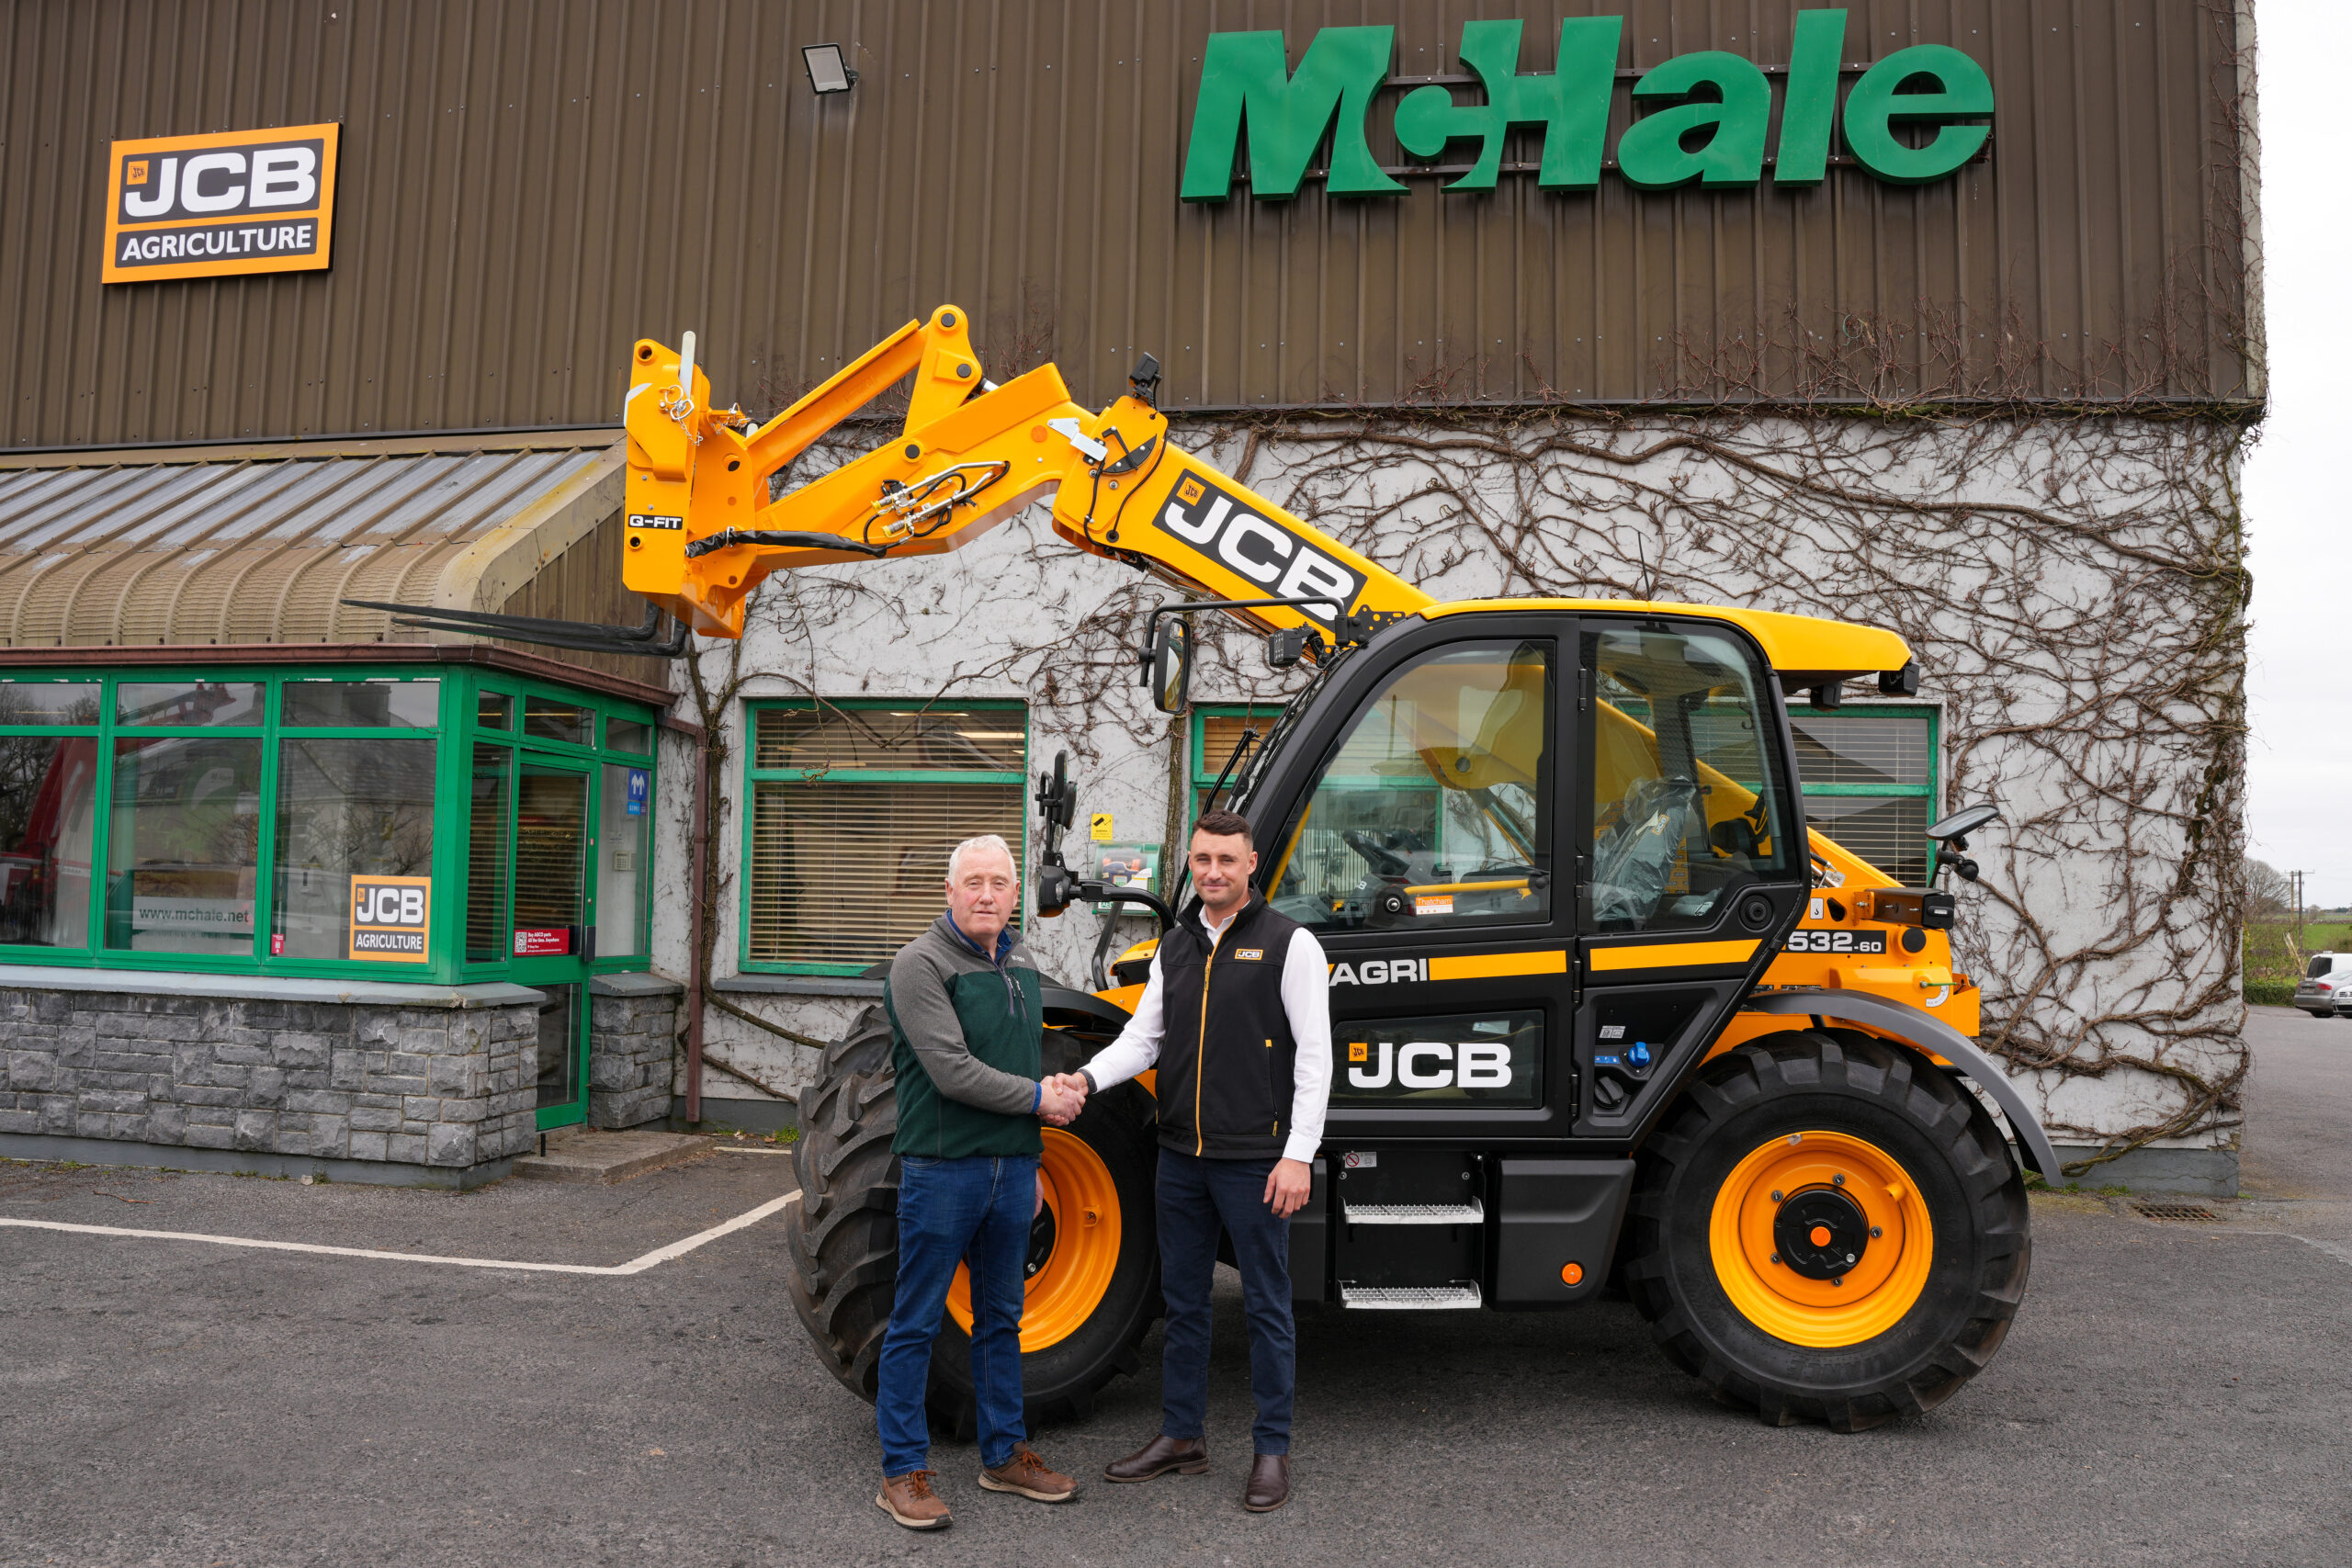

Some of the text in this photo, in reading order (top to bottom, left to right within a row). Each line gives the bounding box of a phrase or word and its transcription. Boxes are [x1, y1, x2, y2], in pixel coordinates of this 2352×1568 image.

[1181, 8, 1995, 202] McHale
[125, 147, 316, 218] JCB
[121, 225, 311, 262] AGRICULTURE
[629, 515, 682, 530] Q-FIT
[1164, 495, 1355, 621] JCB
[140, 908, 249, 923] www.mchale.net
[356, 887, 424, 924] JCB
[1418, 897, 1452, 906] Thatcham
[356, 933, 423, 950] AGRICULTURE
[1788, 931, 1882, 953] 532-60
[1329, 958, 1428, 987] AGRI
[1348, 1043, 1512, 1089] JCB
